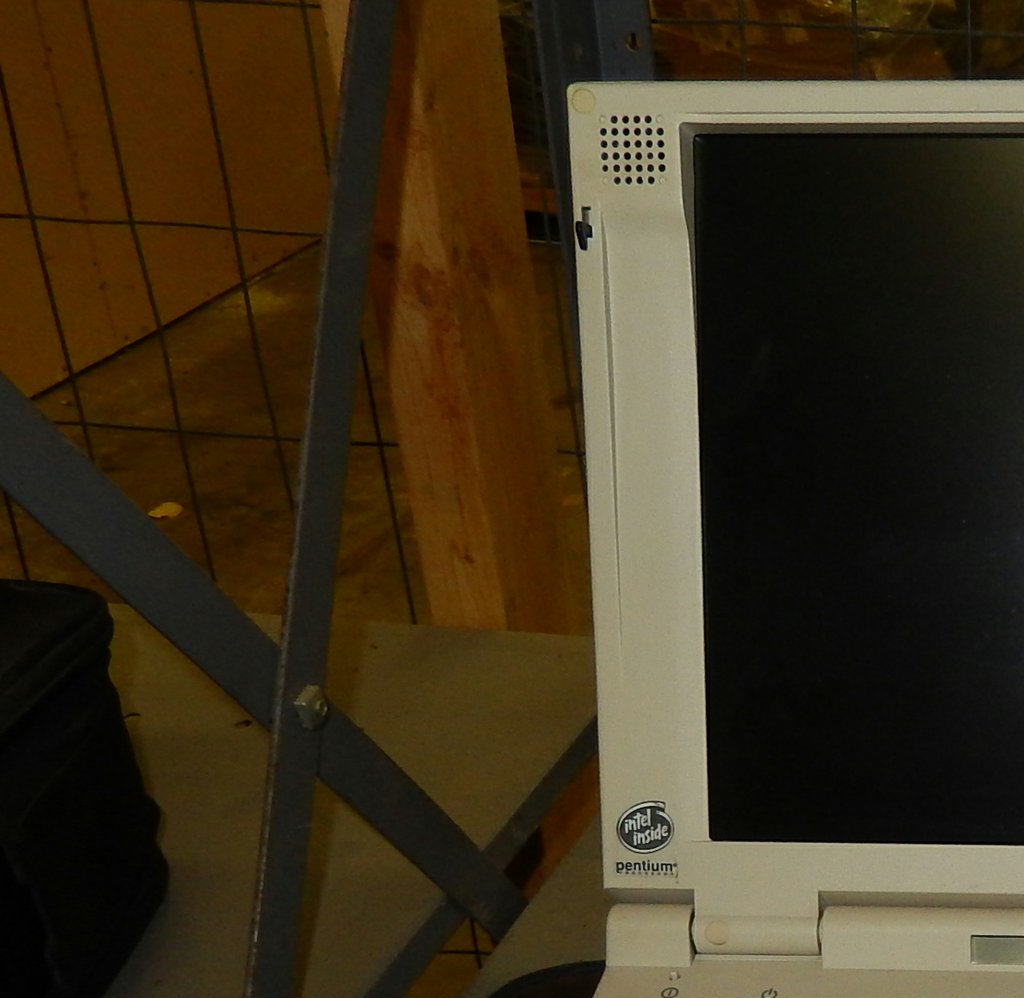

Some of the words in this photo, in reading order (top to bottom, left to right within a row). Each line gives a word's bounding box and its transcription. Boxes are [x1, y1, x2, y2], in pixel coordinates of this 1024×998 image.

[624, 808, 652, 834] intel
[632, 823, 669, 846] inside
[615, 859, 673, 874] pentium
